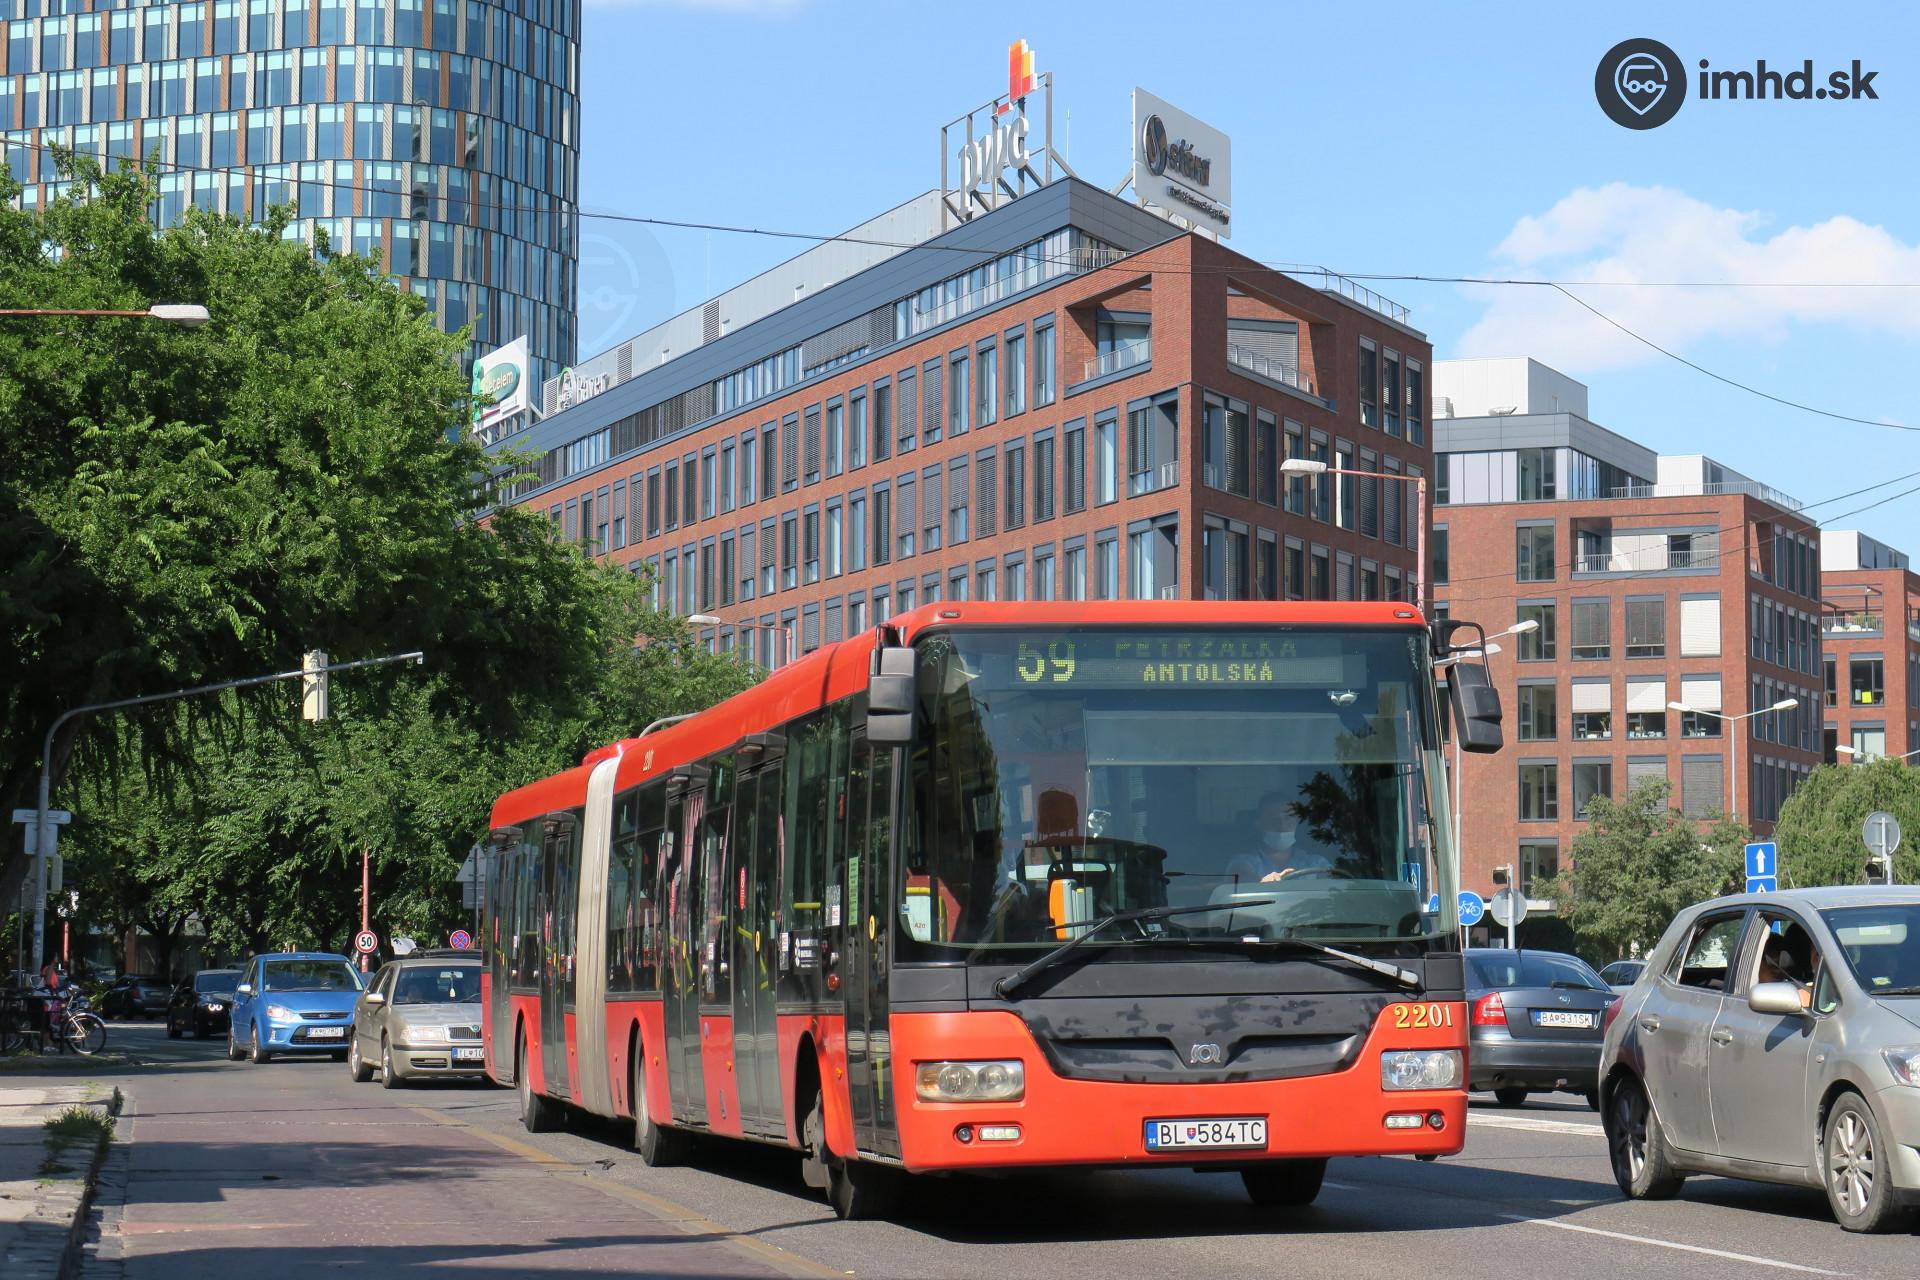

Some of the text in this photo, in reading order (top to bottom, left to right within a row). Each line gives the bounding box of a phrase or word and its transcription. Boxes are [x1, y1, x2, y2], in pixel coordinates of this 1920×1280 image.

[957, 117, 1029, 216] pwc
[1019, 640, 1075, 681] 59
[361, 936, 373, 947] 50
[1394, 1004, 1453, 1028] 2201
